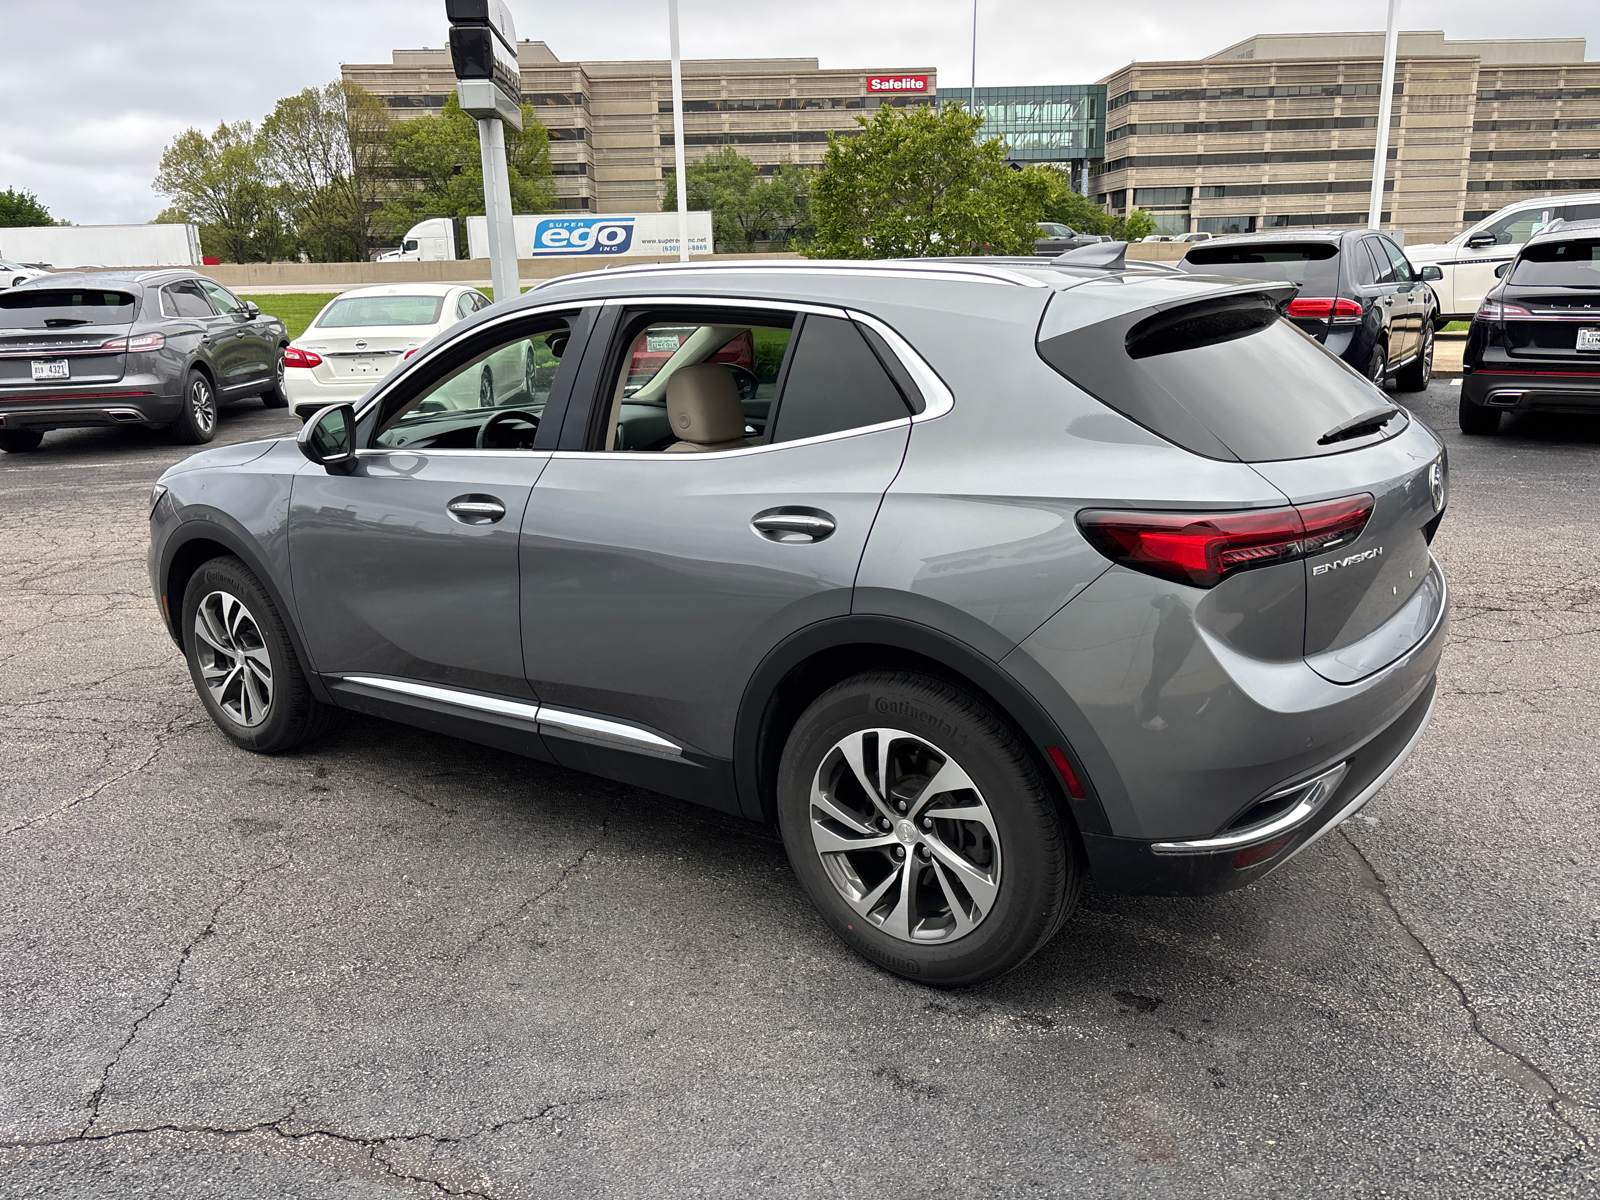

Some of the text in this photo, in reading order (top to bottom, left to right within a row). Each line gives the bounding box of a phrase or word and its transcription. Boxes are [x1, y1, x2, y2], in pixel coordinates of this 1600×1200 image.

[871, 78, 924, 90] Safelite
[541, 226, 627, 251] ego
[48, 364, 65, 375] 4321
[1312, 546, 1384, 576] ENVISION
[205, 570, 240, 592] Continental
[874, 696, 959, 740] Continental
